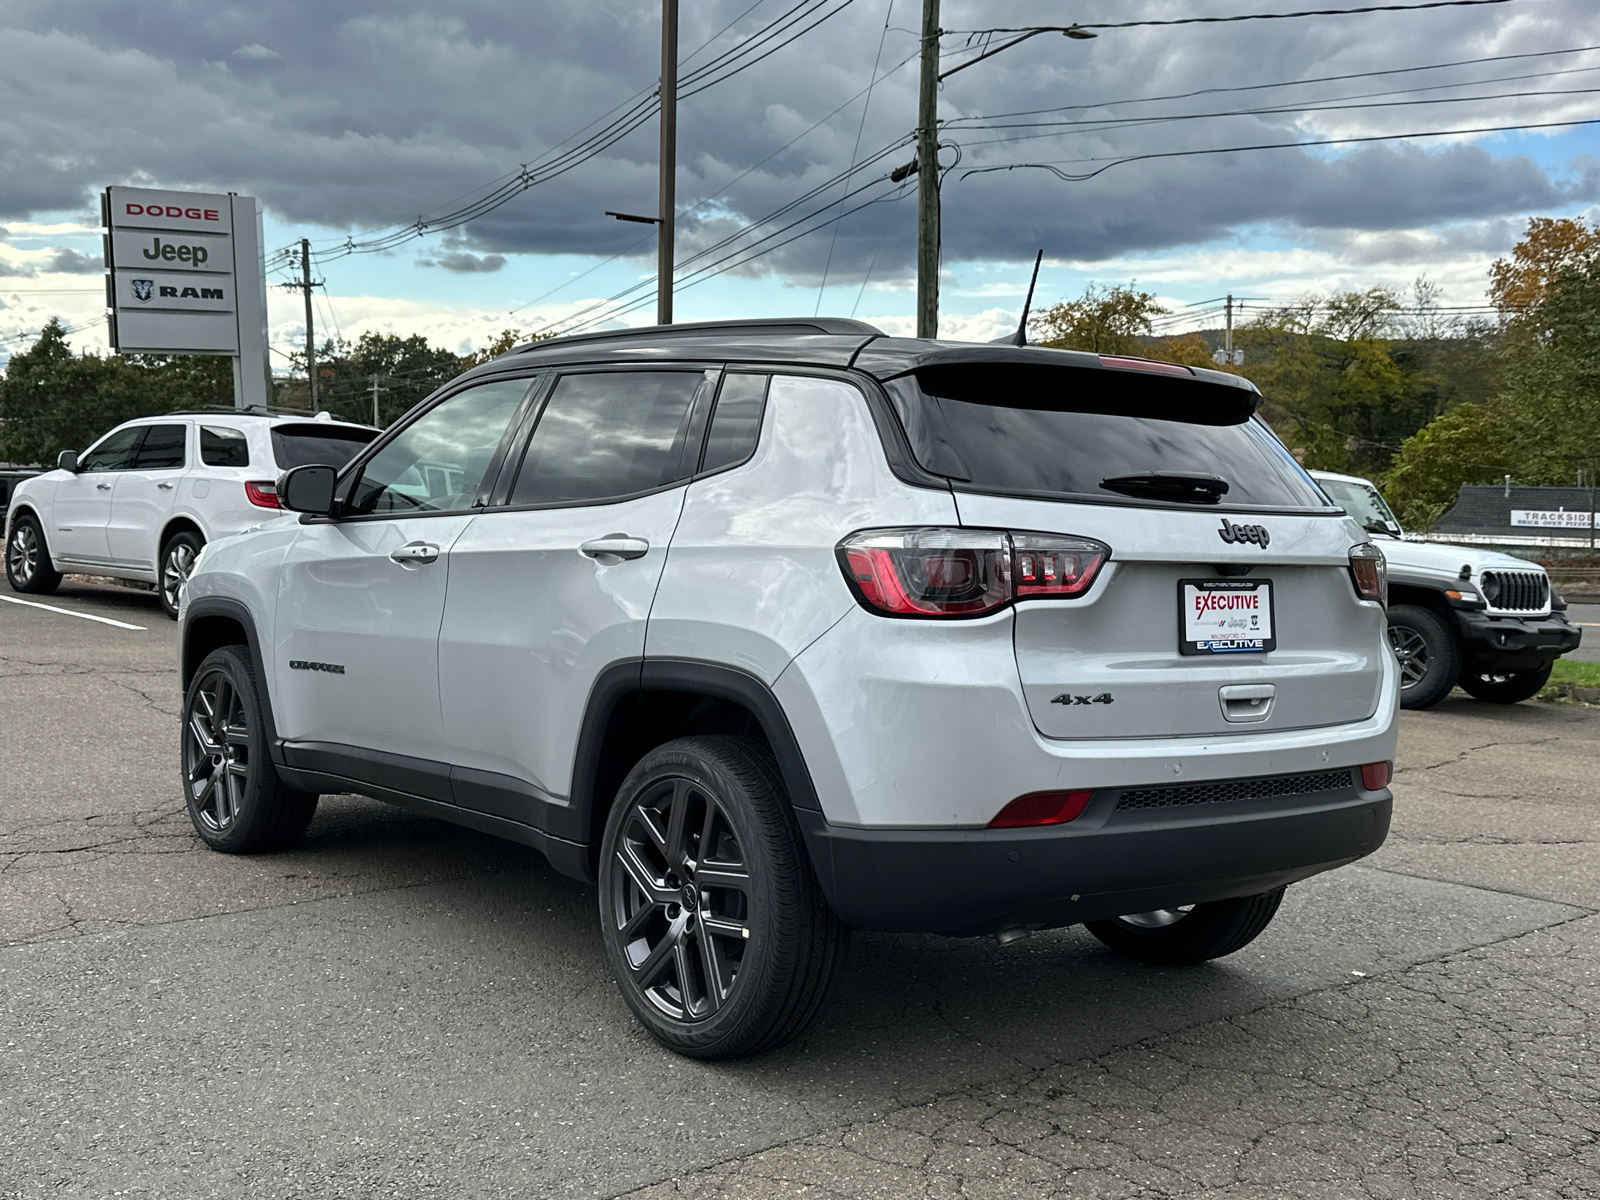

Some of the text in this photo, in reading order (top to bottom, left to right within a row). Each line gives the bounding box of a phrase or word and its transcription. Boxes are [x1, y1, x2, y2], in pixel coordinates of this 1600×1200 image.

[126, 203, 219, 221] DODGE
[143, 237, 208, 267] Jeep
[159, 286, 224, 300] RAM
[1524, 512, 1593, 521] TRACKSIDE
[1218, 518, 1270, 549] Jeep
[1195, 591, 1258, 619] EXECUTIVE
[1227, 617, 1247, 629] Jeep
[1197, 639, 1263, 650] EXECUTIVE
